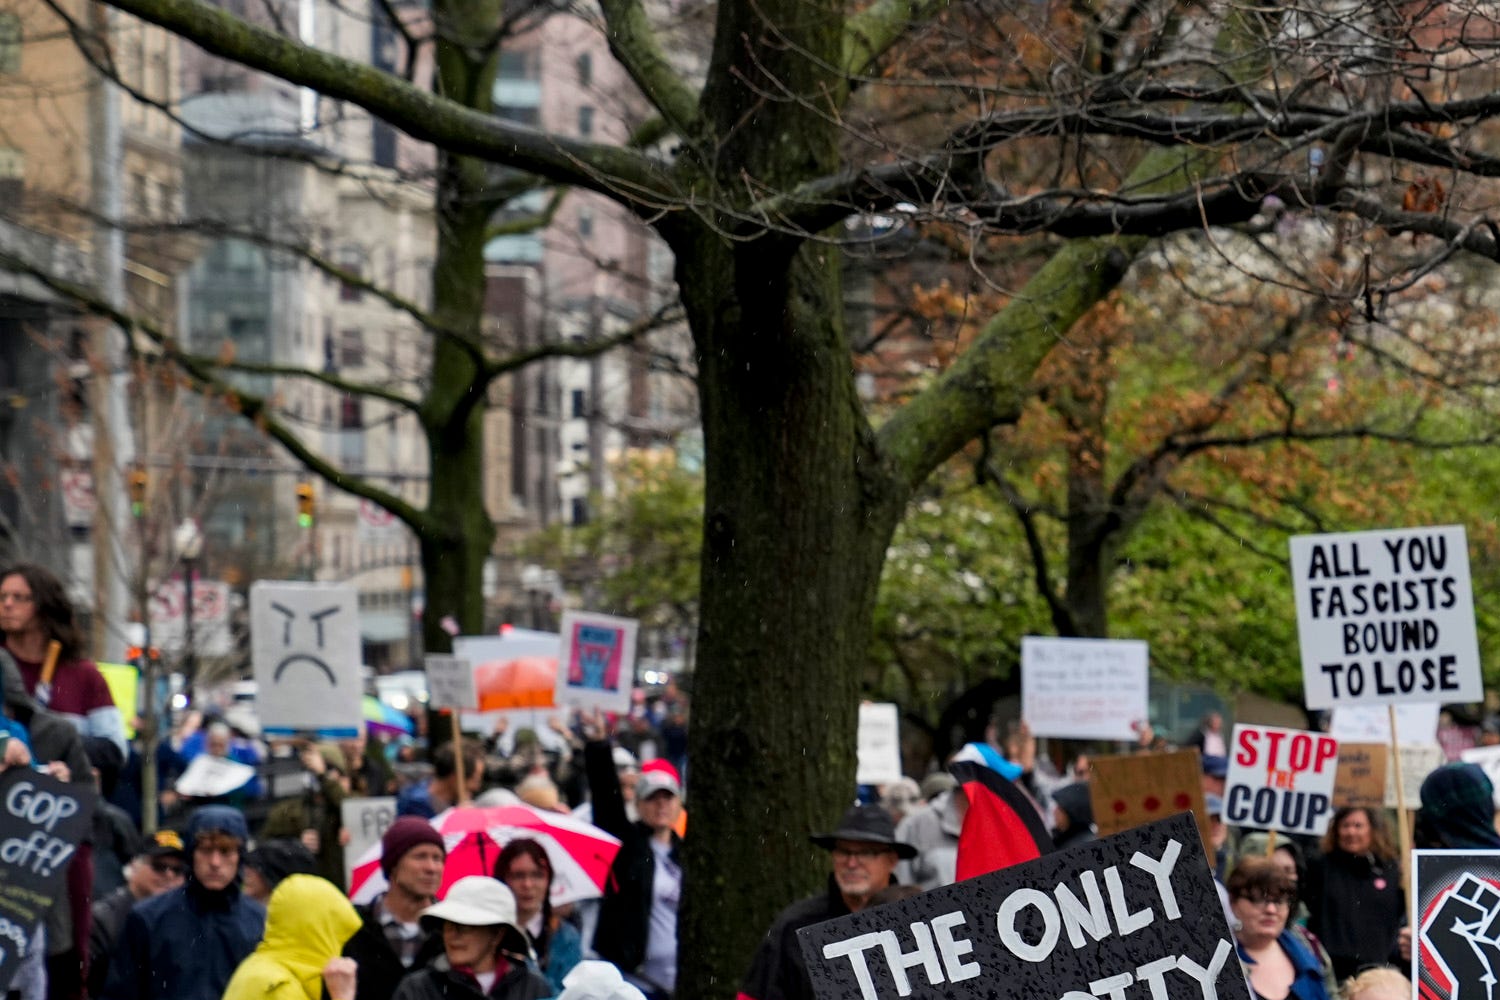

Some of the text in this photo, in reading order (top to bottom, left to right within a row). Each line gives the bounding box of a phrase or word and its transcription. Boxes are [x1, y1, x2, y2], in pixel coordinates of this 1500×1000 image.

[1308, 535, 1447, 579] ALL YOU
[1310, 577, 1457, 619] FASCISTS
[1343, 619, 1438, 655] BOUND
[1321, 656, 1459, 698] TO LOSE
[1236, 729, 1338, 773] STOP
[6, 781, 79, 831] GOP
[1226, 783, 1329, 829] COUP
[996, 838, 1183, 962] ONLY
